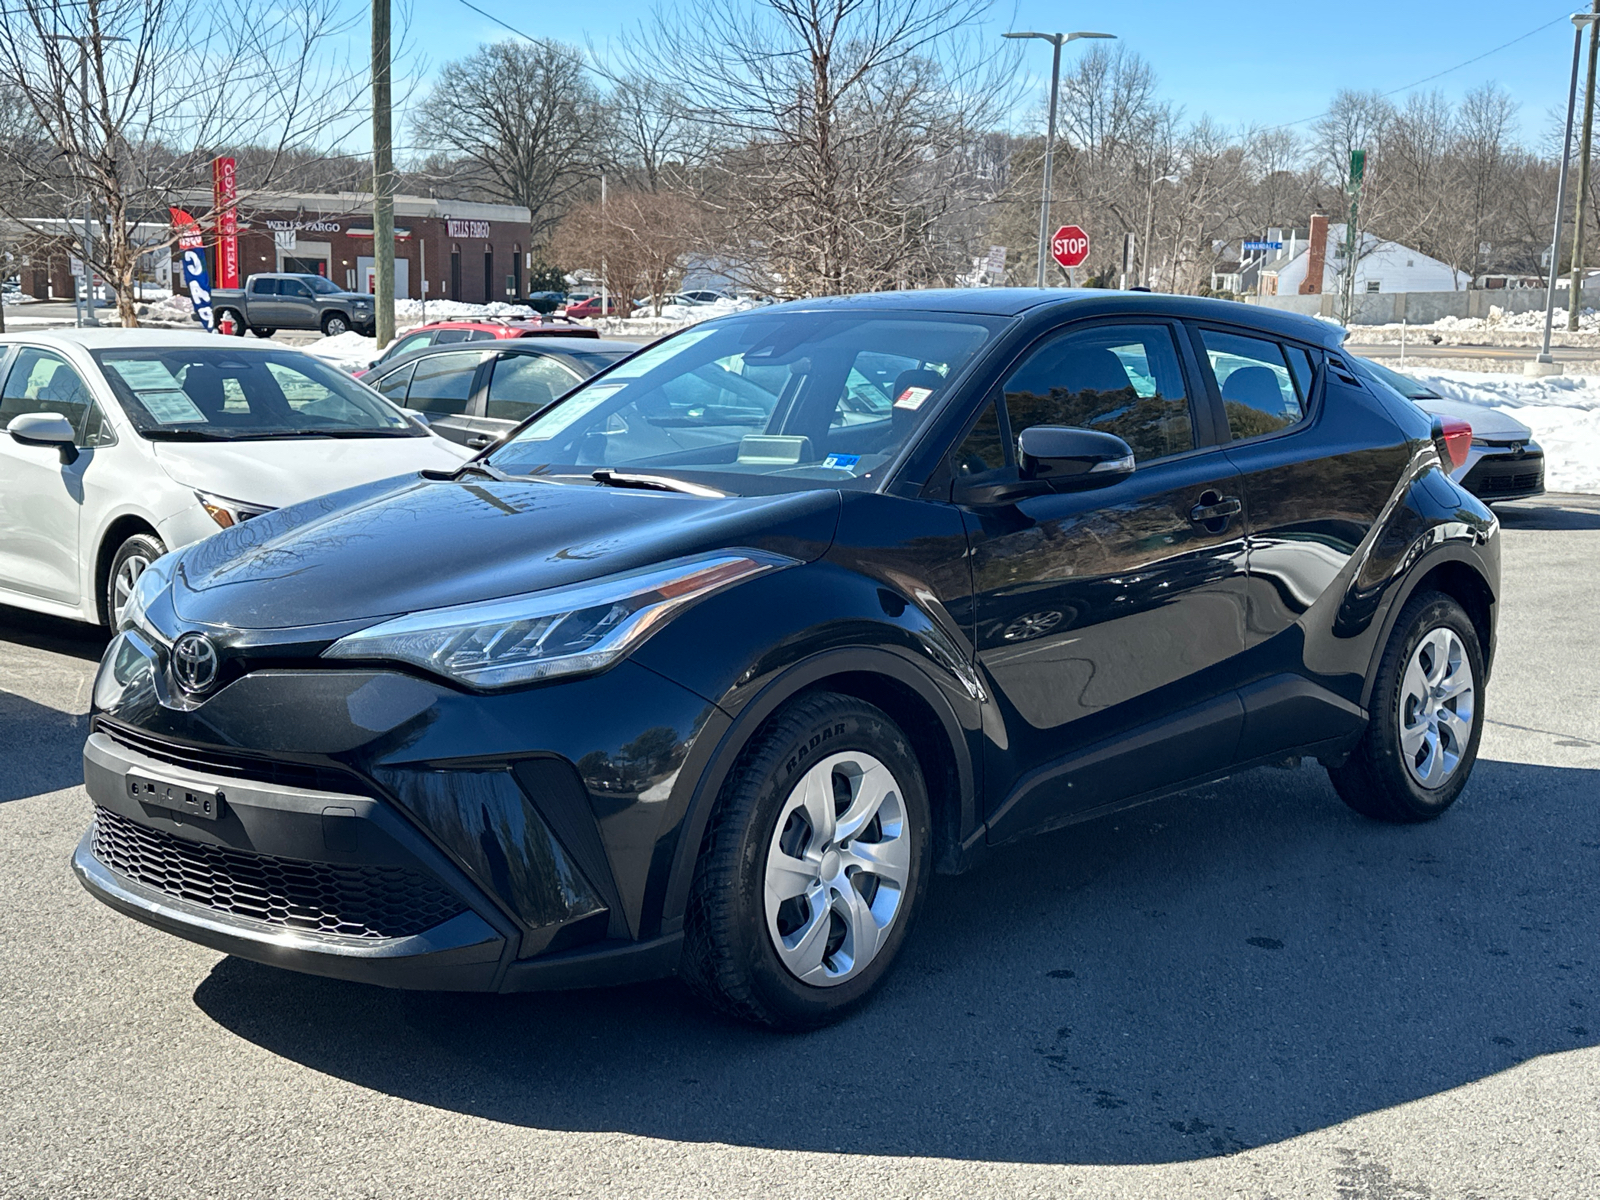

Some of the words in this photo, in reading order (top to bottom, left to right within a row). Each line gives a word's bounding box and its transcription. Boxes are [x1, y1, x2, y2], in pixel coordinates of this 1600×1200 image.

[224, 163, 235, 219] FRGO
[266, 220, 303, 231] WELLS
[305, 221, 341, 233] FARGO
[447, 220, 469, 238] WELLS
[470, 221, 490, 238] FARGO
[226, 222, 236, 280] WELLS
[1054, 238, 1087, 255] STOP
[785, 722, 846, 775] RADAR
